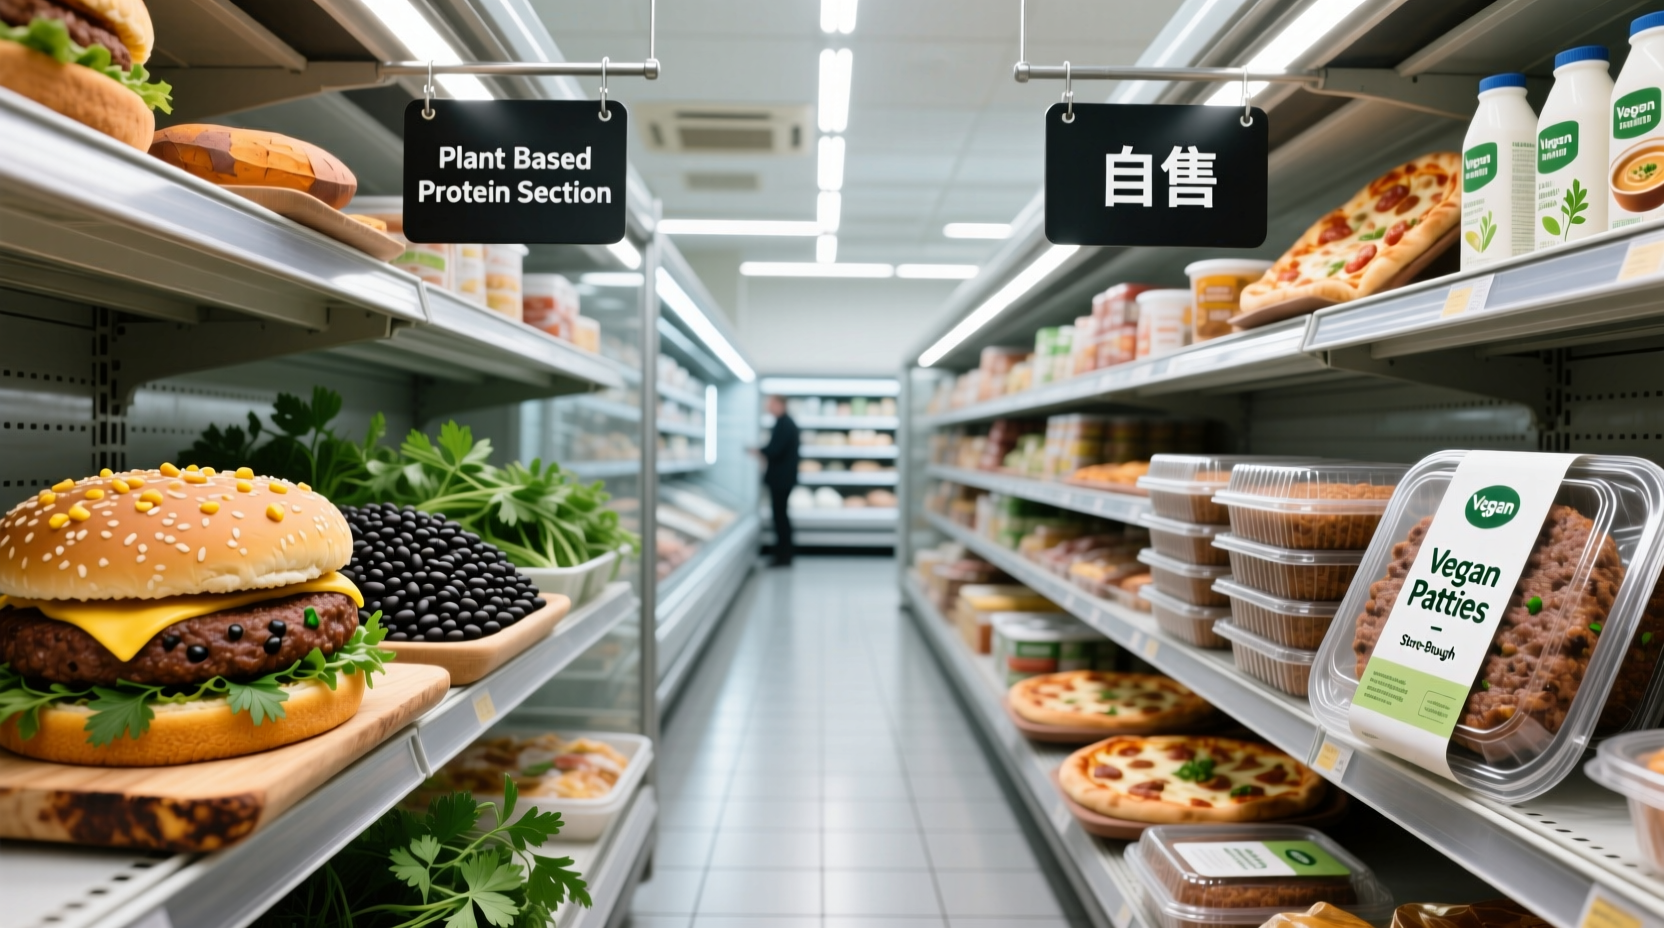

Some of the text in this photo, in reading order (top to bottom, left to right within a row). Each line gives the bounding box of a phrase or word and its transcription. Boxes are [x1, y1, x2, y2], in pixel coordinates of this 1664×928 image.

[1616, 100, 1656, 120] Vegan
[439, 145, 592, 170] Plant Based
[1105, 144, 1218, 208] 自售
[418, 179, 612, 204] Protein Section
[1472, 493, 1515, 518] Vegan
[1430, 546, 1501, 588] Vegan
[1406, 578, 1490, 624] Patties
